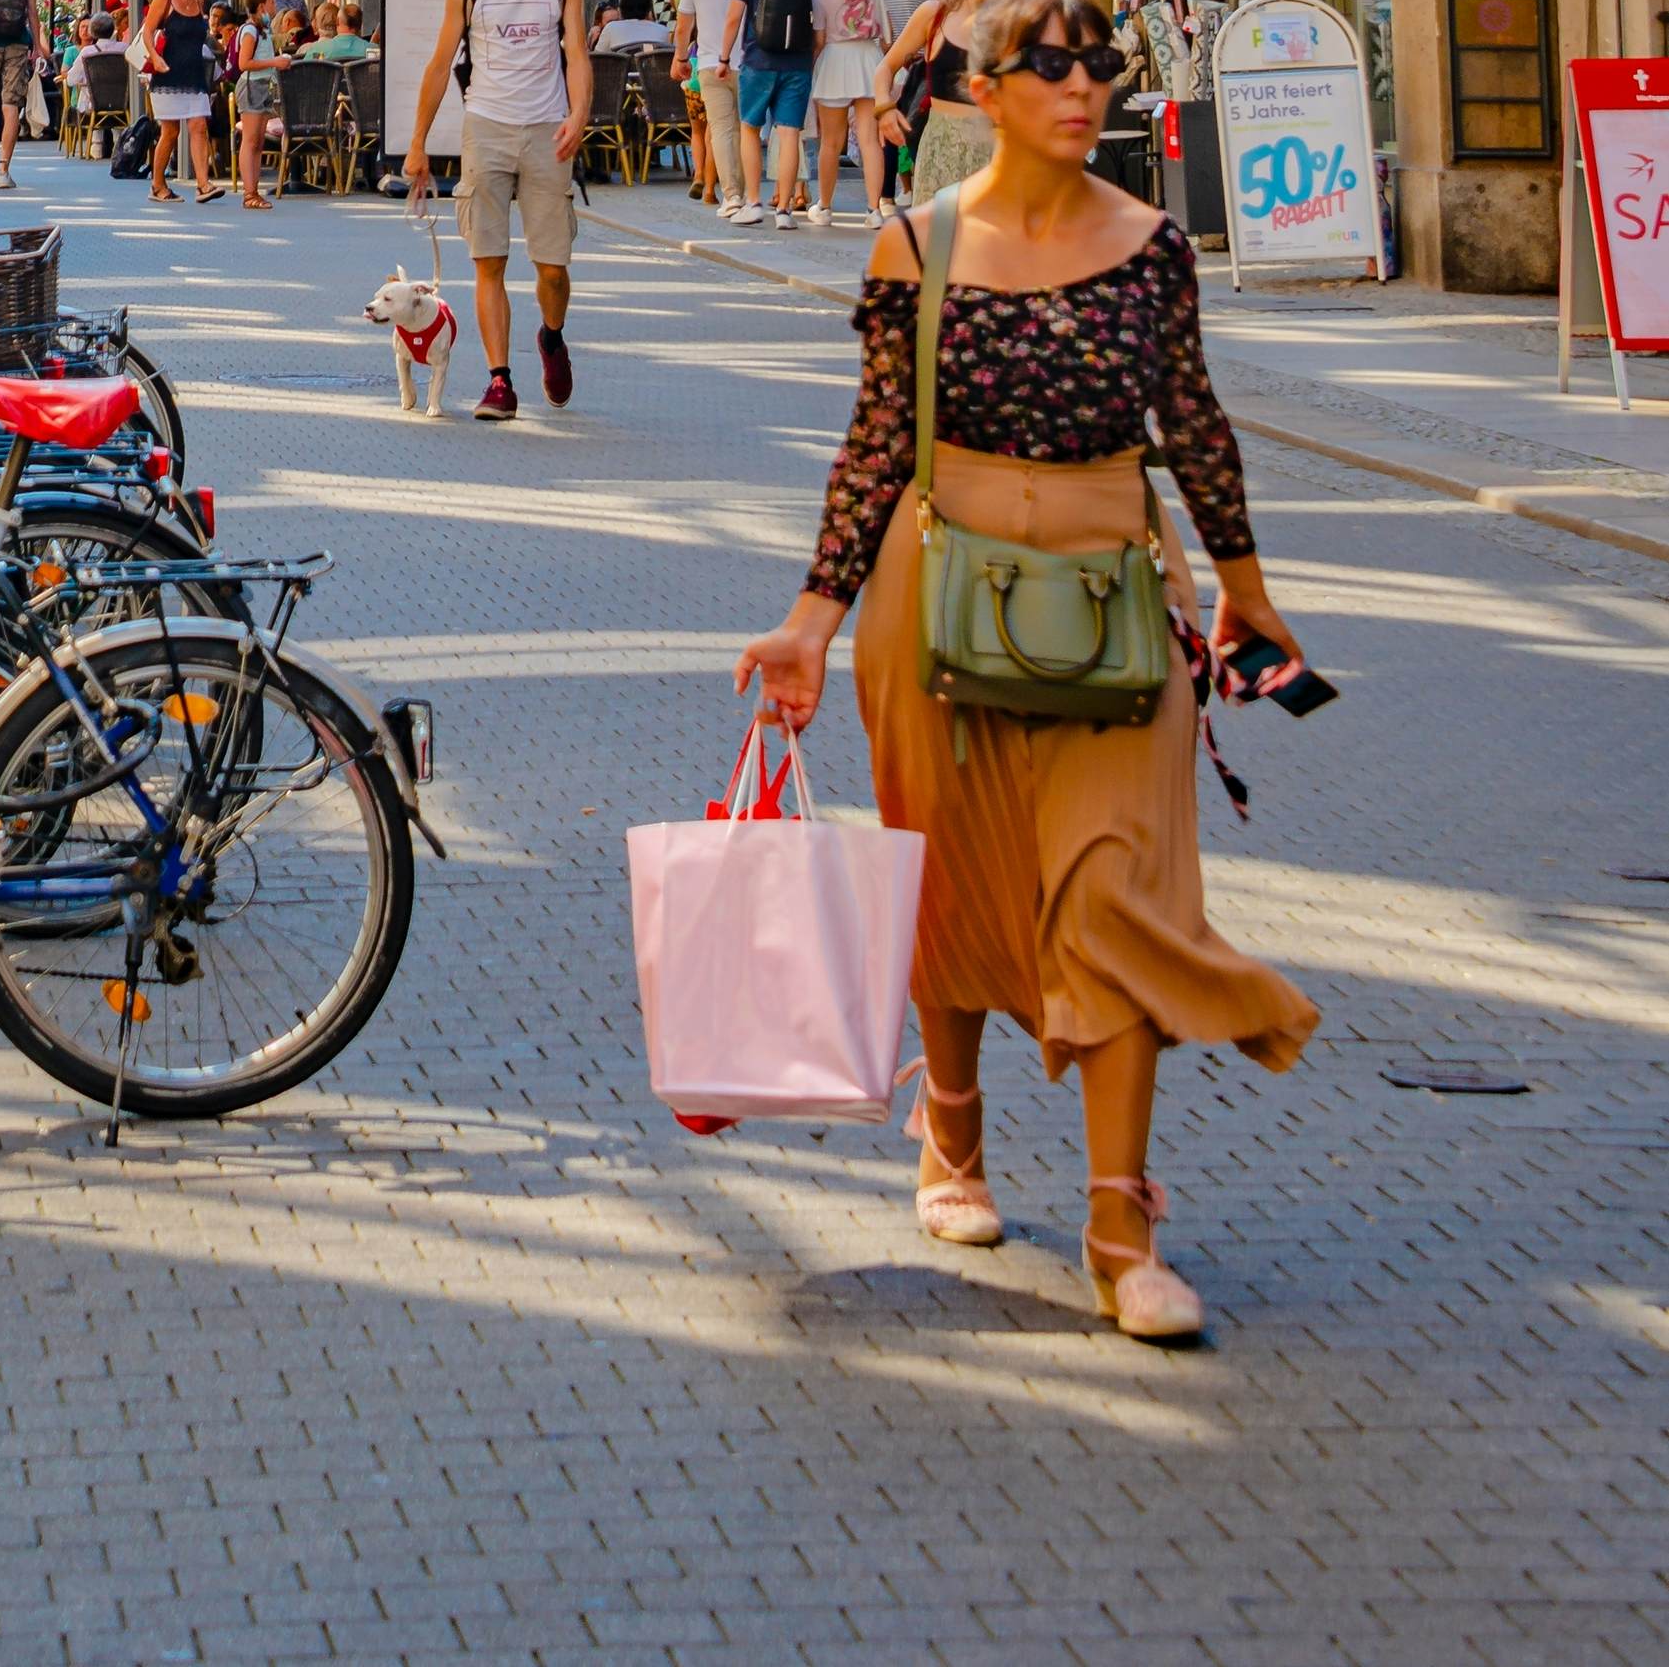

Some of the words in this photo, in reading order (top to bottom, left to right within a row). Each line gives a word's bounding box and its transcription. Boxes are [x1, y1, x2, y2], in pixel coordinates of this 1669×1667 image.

[496, 22, 541, 38] VANS
[1228, 84, 1277, 102] PŸUR
[1283, 83, 1333, 99] feiert
[1230, 106, 1240, 120] 5
[1247, 104, 1305, 120] Jahre.
[1239, 135, 1357, 219] 50%
[1271, 188, 1346, 231] RABATT
